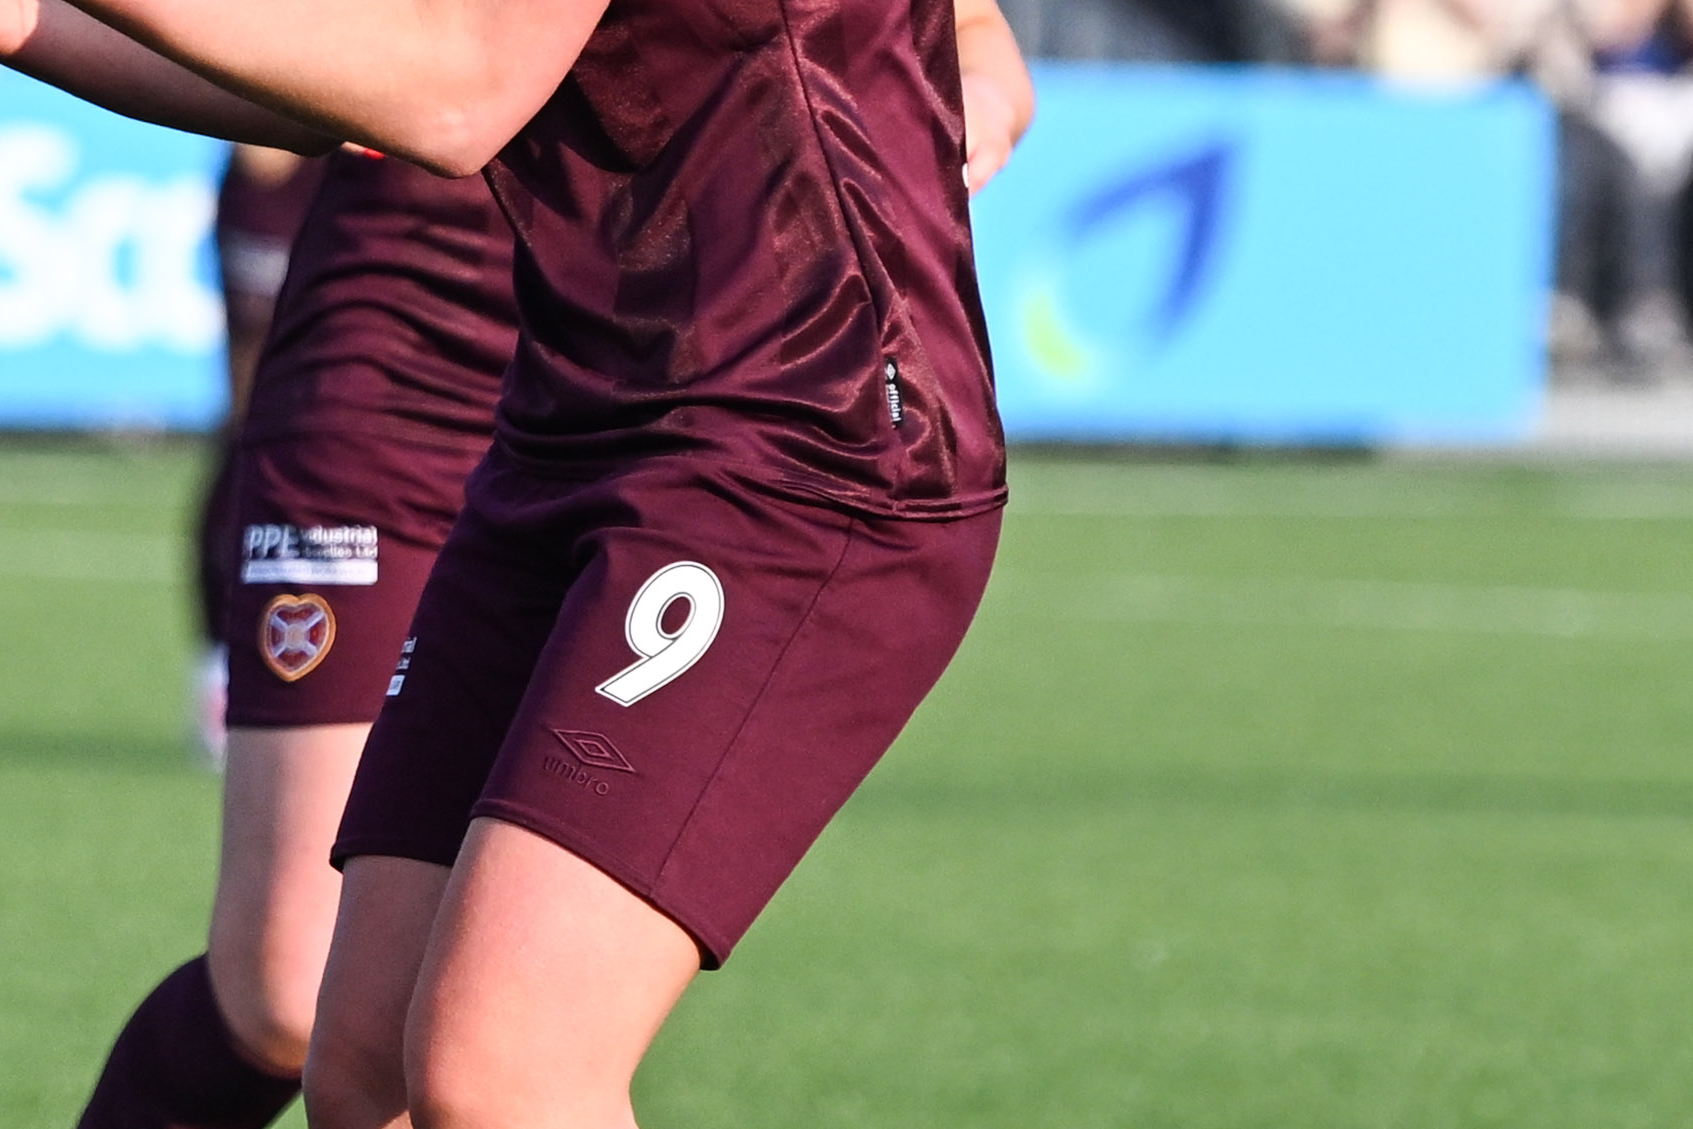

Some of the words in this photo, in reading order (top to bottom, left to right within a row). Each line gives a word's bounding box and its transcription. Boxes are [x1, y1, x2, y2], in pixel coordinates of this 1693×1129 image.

[245, 524, 300, 559] PPE
[594, 560, 725, 708] 9
[543, 756, 610, 796] umbro
